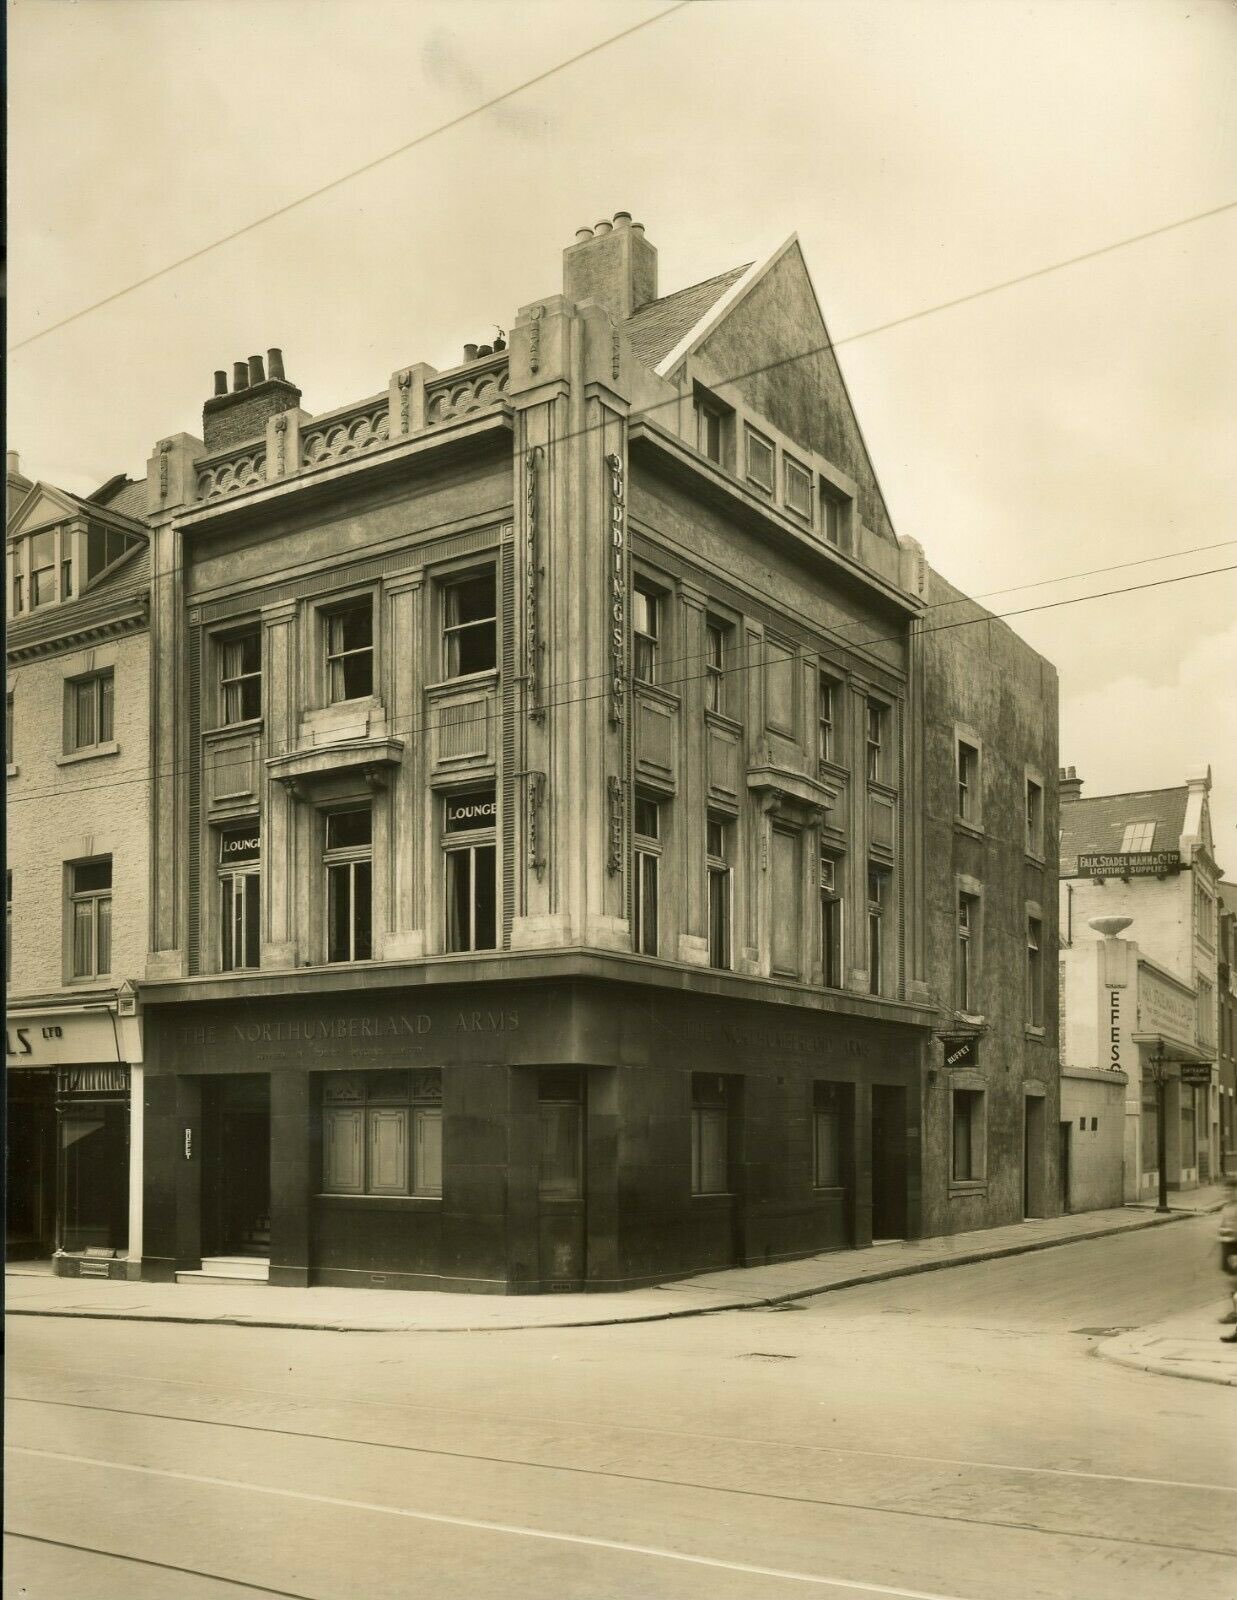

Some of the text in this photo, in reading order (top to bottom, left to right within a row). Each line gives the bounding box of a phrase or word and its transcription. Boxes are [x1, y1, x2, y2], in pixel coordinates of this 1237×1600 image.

[1090, 865, 1168, 875] LIGHTING SUPPLIES
[42, 1026, 63, 1039] LTD
[183, 1010, 520, 1045] THE NORTHUMBERLAND ARMS
[947, 1045, 970, 1064] BUFFET
